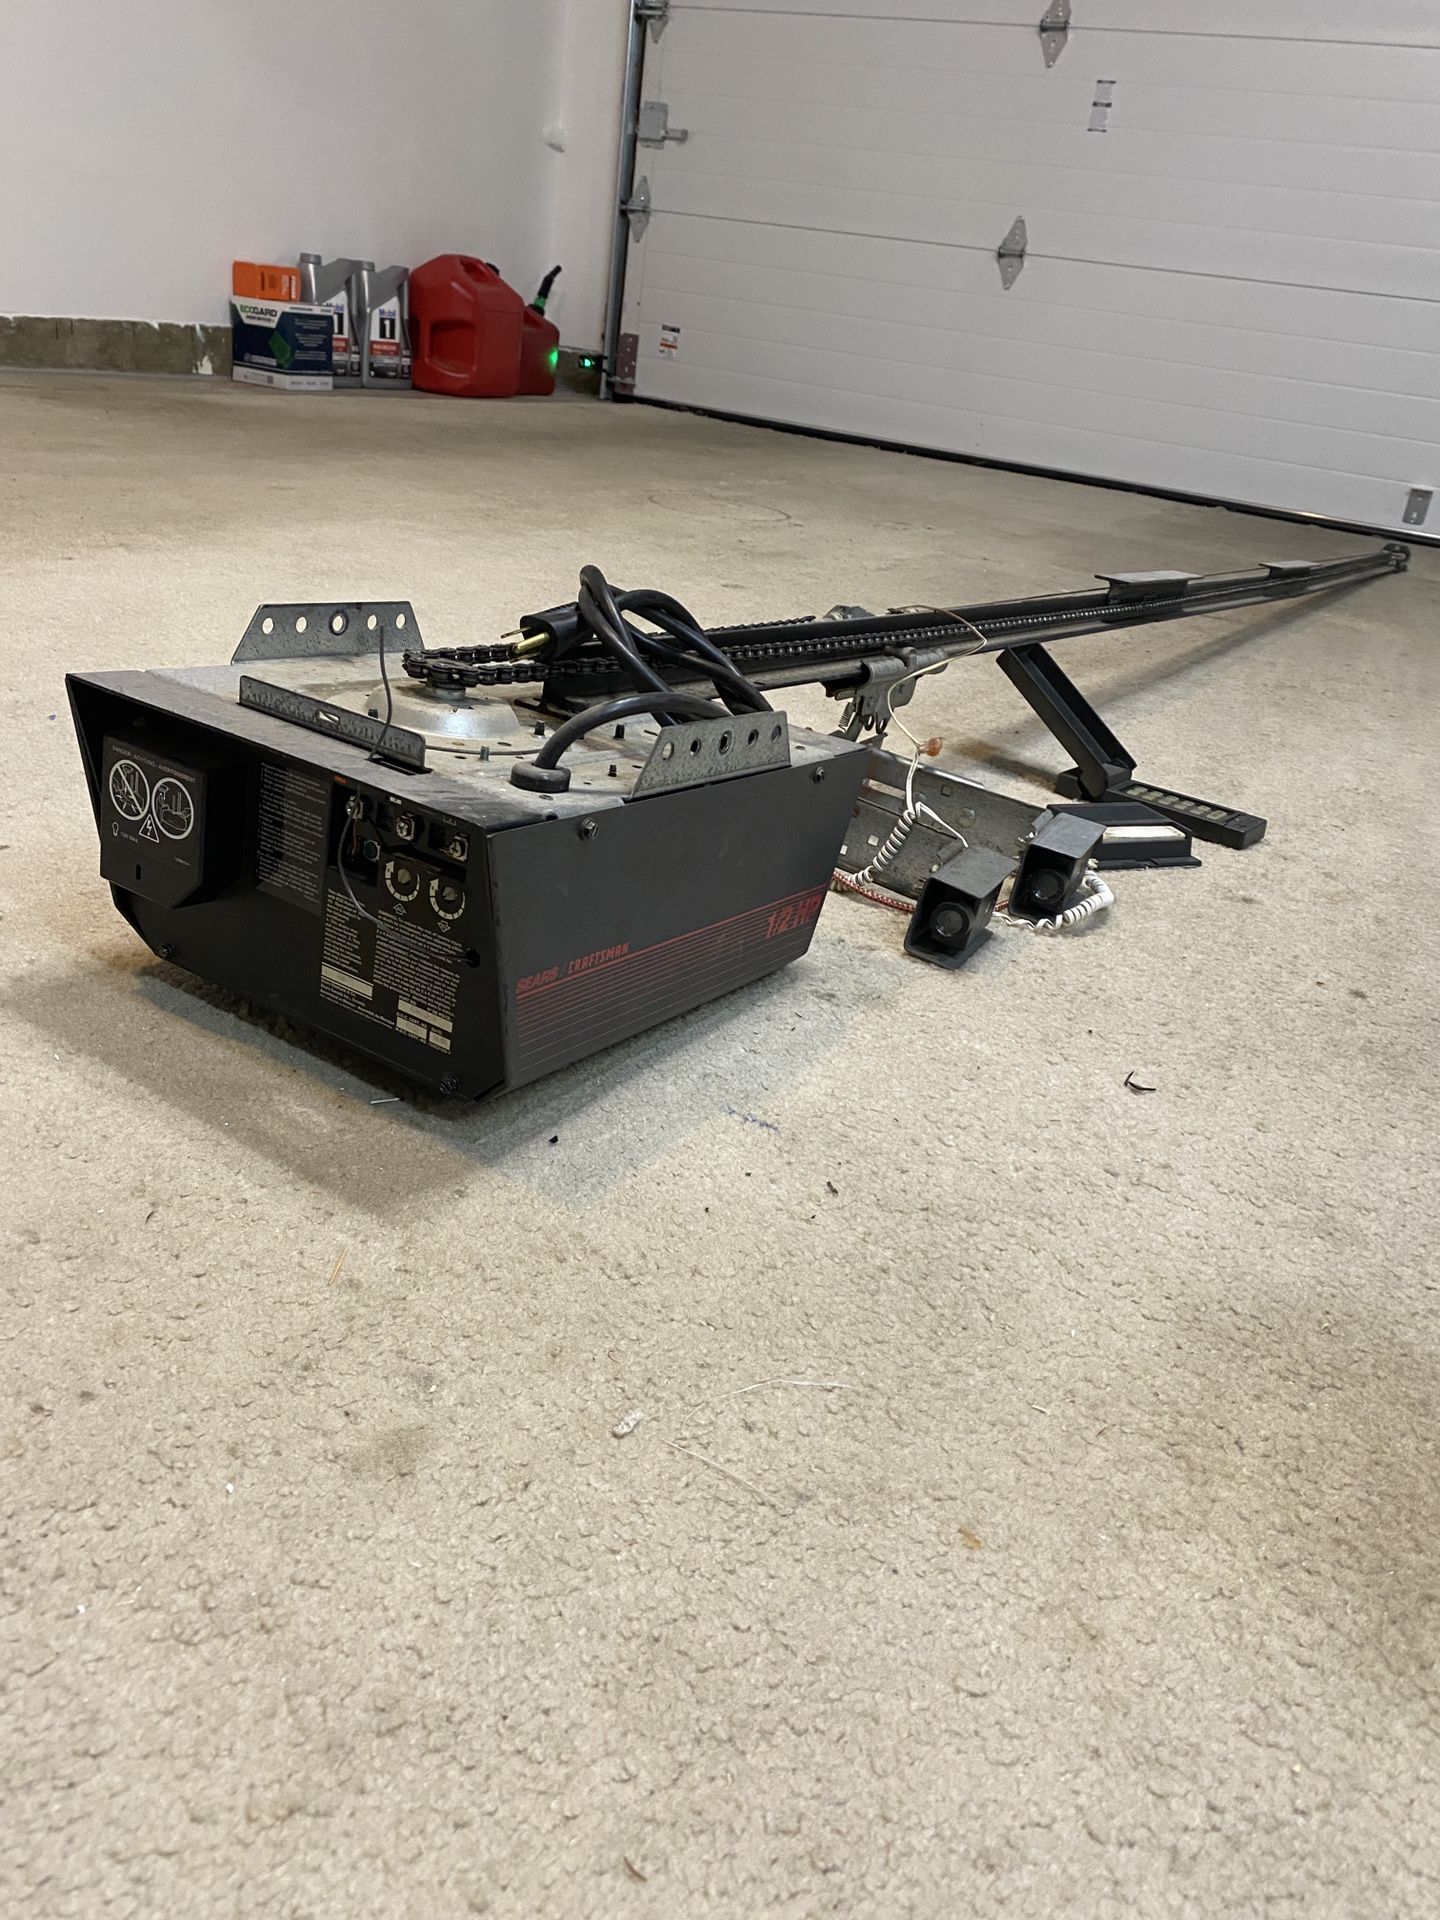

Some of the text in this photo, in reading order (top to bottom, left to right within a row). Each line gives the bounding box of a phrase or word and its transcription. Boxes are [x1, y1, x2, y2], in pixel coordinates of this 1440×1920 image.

[240, 305, 278, 318] ECOGARD
[379, 309, 396, 317] Mobil
[793, 894, 822, 929] HP
[516, 966, 559, 993] SEARS
[568, 942, 630, 974] CRAFTSMAN
